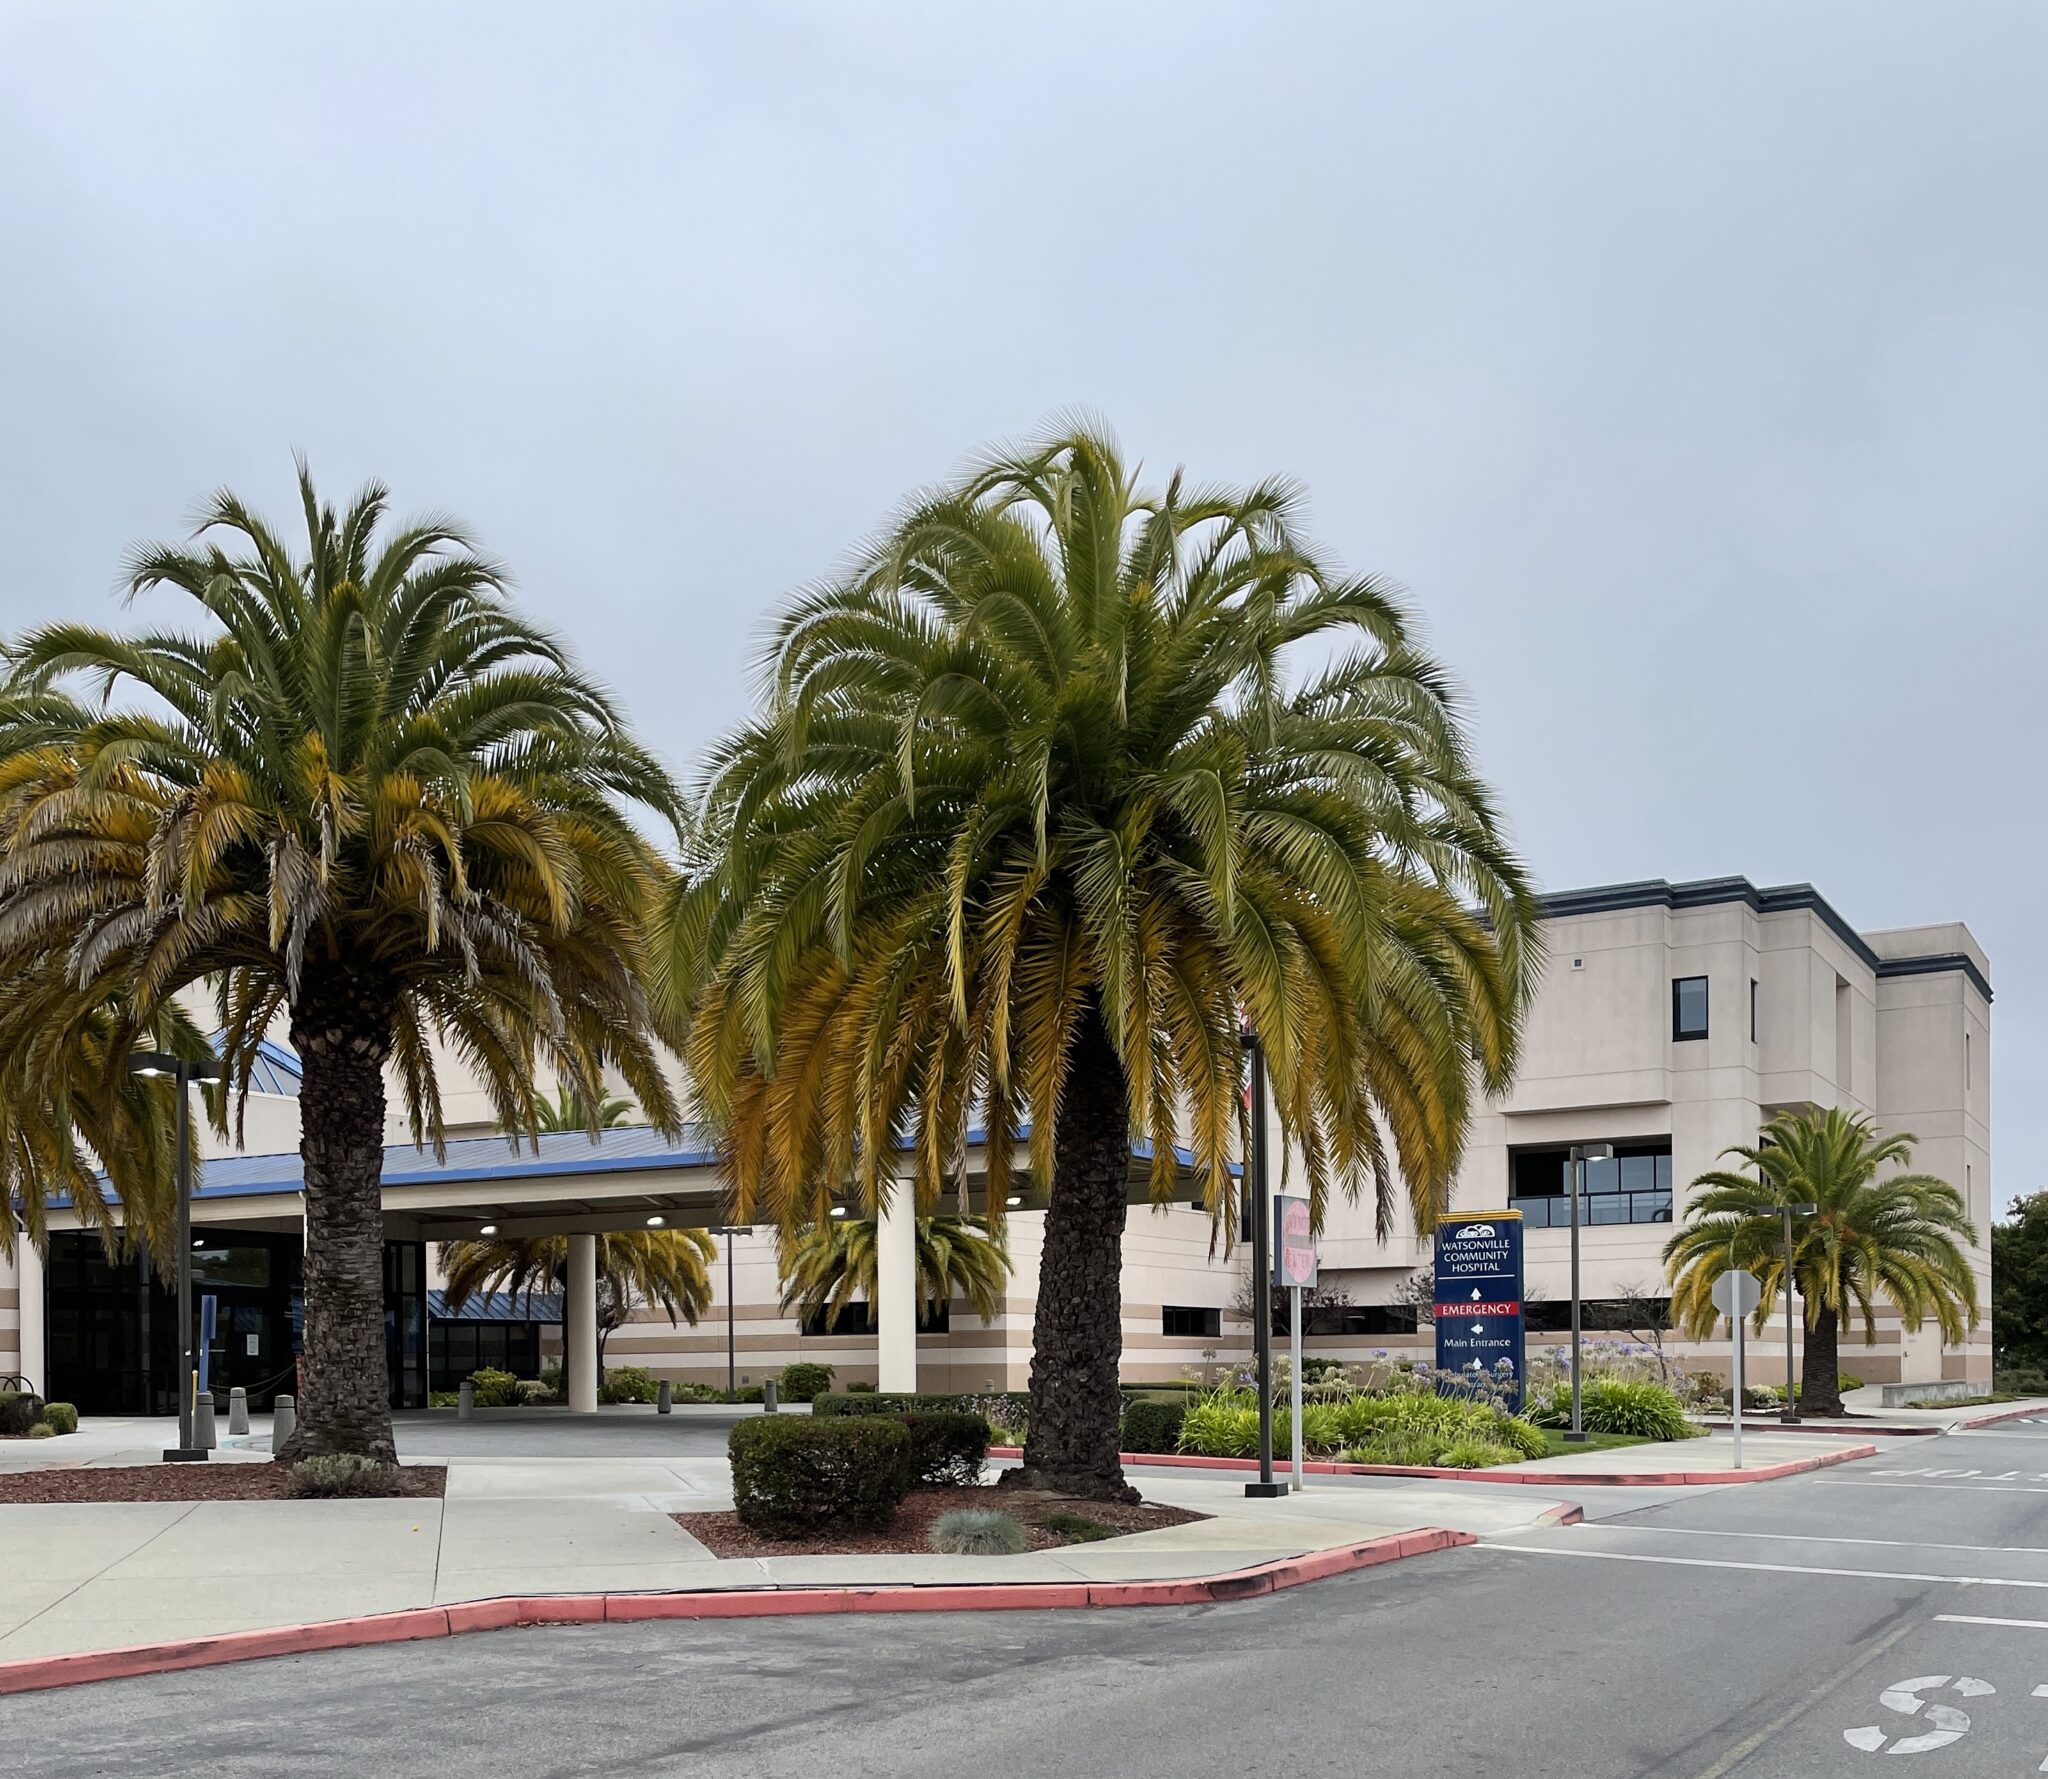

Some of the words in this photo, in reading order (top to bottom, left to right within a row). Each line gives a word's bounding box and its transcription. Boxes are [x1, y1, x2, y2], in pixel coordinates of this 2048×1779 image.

[1441, 1239, 1510, 1251] WATSONVILLE
[1443, 1250, 1509, 1262] COMMUNITY
[1452, 1262, 1500, 1272] HOSPITAL
[1442, 1303, 1511, 1315] EMERGENCY
[1444, 1338, 1468, 1348] Main
[1470, 1338, 1511, 1348] Entrance
